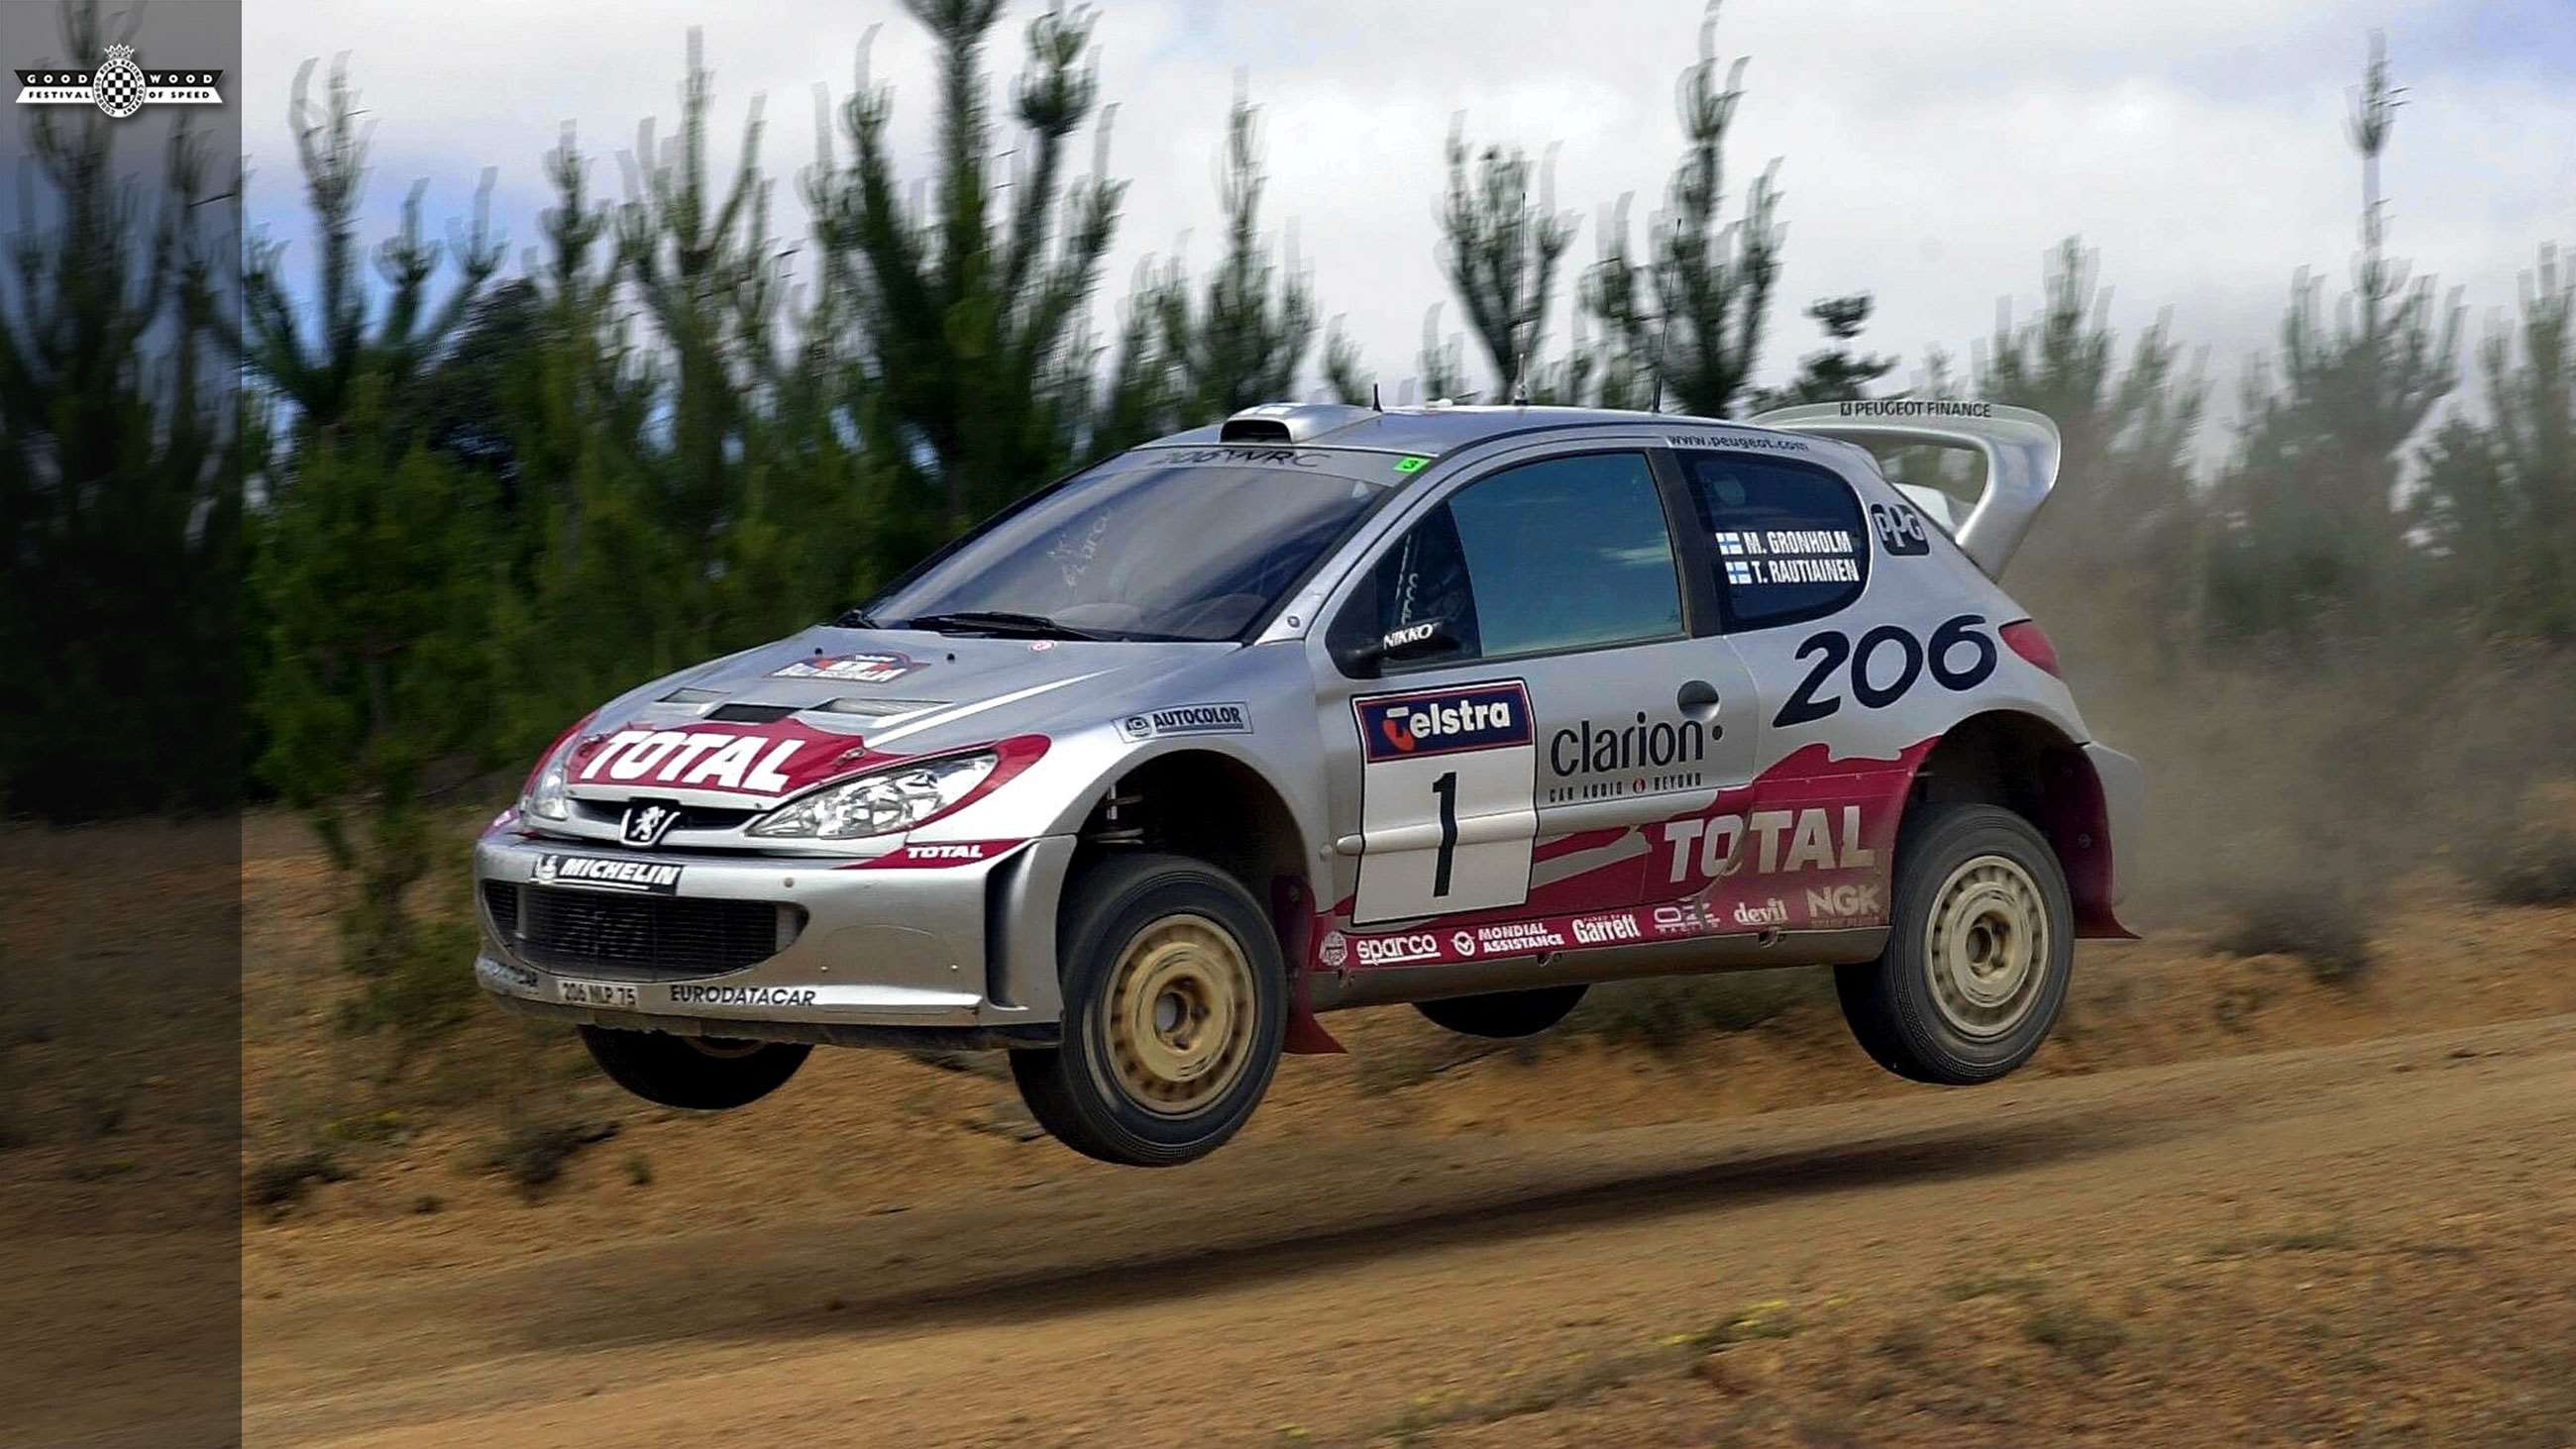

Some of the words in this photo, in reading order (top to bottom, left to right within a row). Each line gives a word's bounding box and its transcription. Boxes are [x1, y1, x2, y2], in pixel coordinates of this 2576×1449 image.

[1855, 400, 1923, 417] PEUGEOT
[1926, 401, 1992, 418] FINANCE
[1667, 434, 1809, 451] www.peugeot.com
[1743, 531, 1768, 555] M.
[1768, 530, 1854, 555] GRONHOLM
[1751, 561, 1769, 584] T.
[1769, 559, 1860, 583] RAUTIAINEN
[1383, 623, 1434, 650] NIKKO
[1772, 615, 1997, 728] 206
[1153, 707, 1242, 728] AUTOCOLOR
[1384, 699, 1511, 751] Telstra
[579, 731, 805, 793] TOTAL
[1433, 772, 1457, 897] 1
[1664, 805, 1876, 883] TOTAL
[907, 844, 985, 859] TOTAL
[559, 858, 681, 885] MICHELIN
[1734, 898, 1788, 924] devil
[1806, 884, 1881, 918] NGK
[1478, 922, 1548, 942] MONDIAL
[1571, 914, 1642, 945] Garrett
[1356, 934, 1438, 961] sparco
[1483, 933, 1565, 953] ASSISTANCE
[617, 986, 636, 1005] 75
[669, 984, 816, 1006] EURODATACAR
